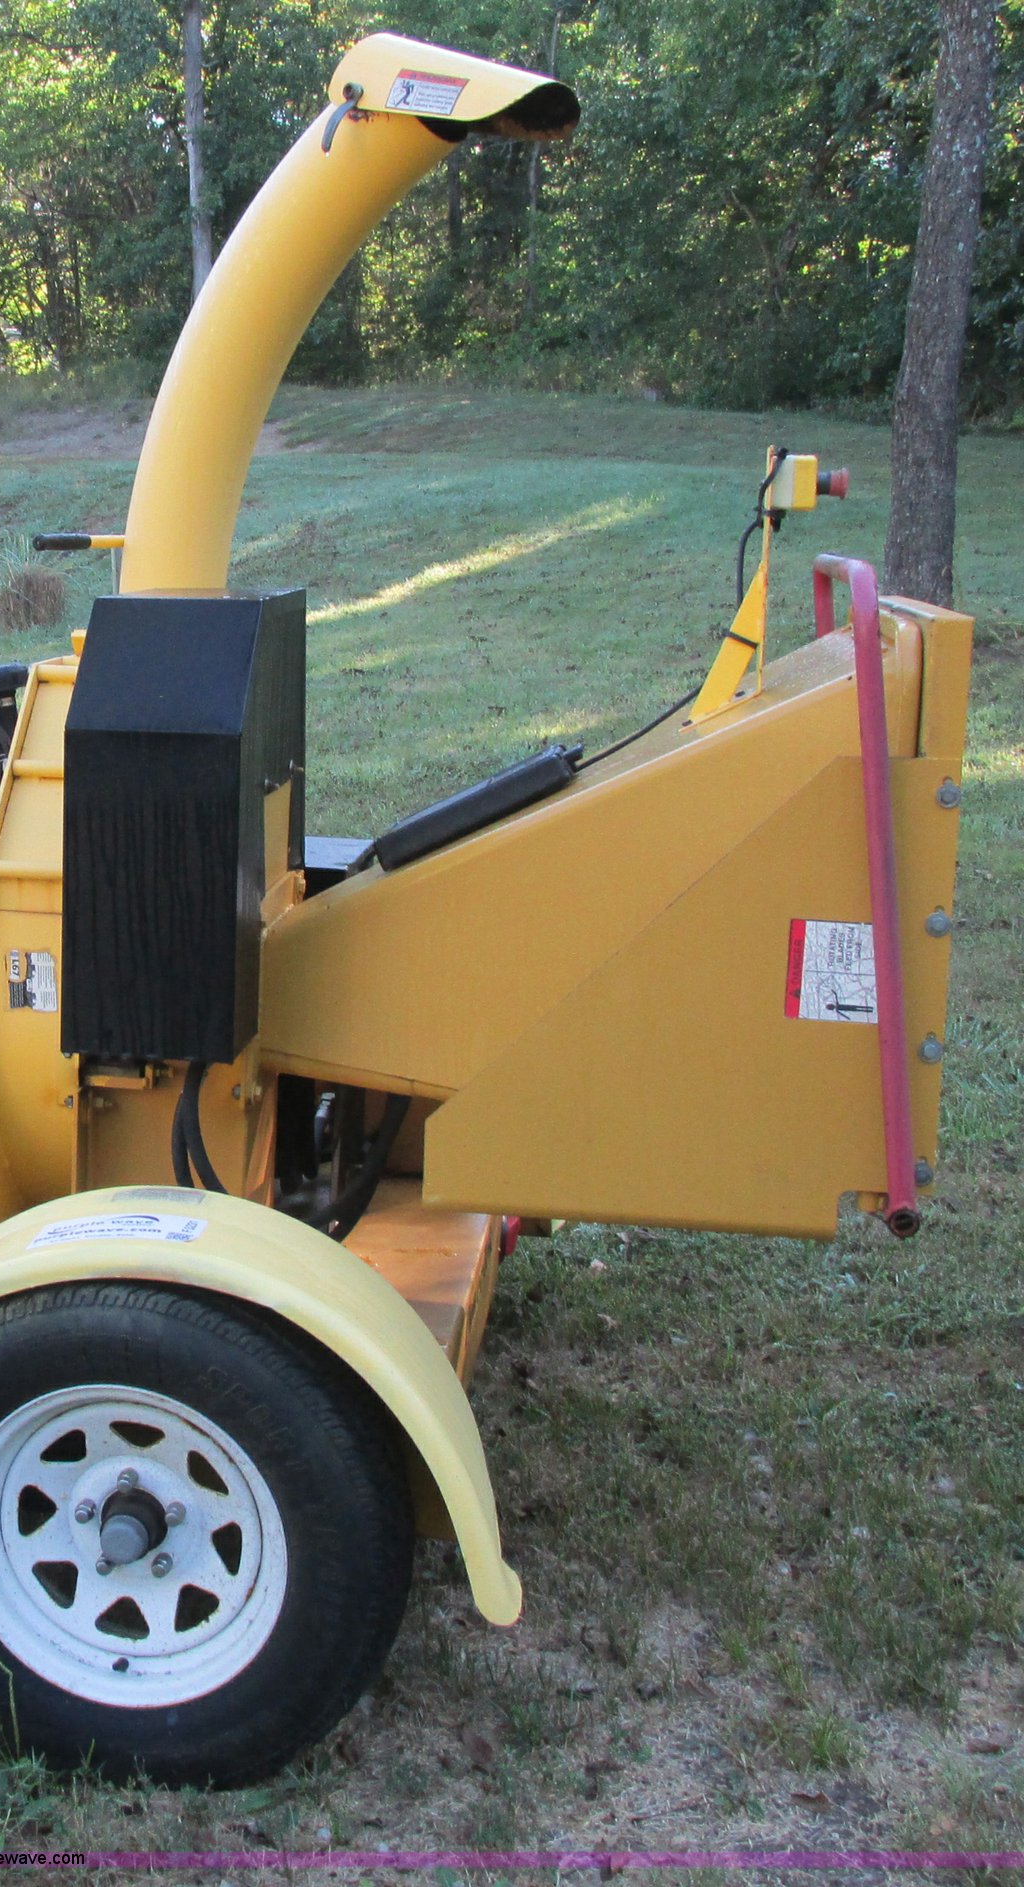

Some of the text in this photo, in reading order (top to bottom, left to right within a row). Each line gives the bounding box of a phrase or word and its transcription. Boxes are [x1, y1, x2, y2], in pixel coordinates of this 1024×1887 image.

[827, 927, 838, 969] ROTATING
[836, 932, 846, 964] BLADES
[845, 926, 856, 950] FROM
[11, 959, 20, 977] L67
[791, 940, 803, 984] DANGER
[33, 1227, 163, 1244] purplewave.com
